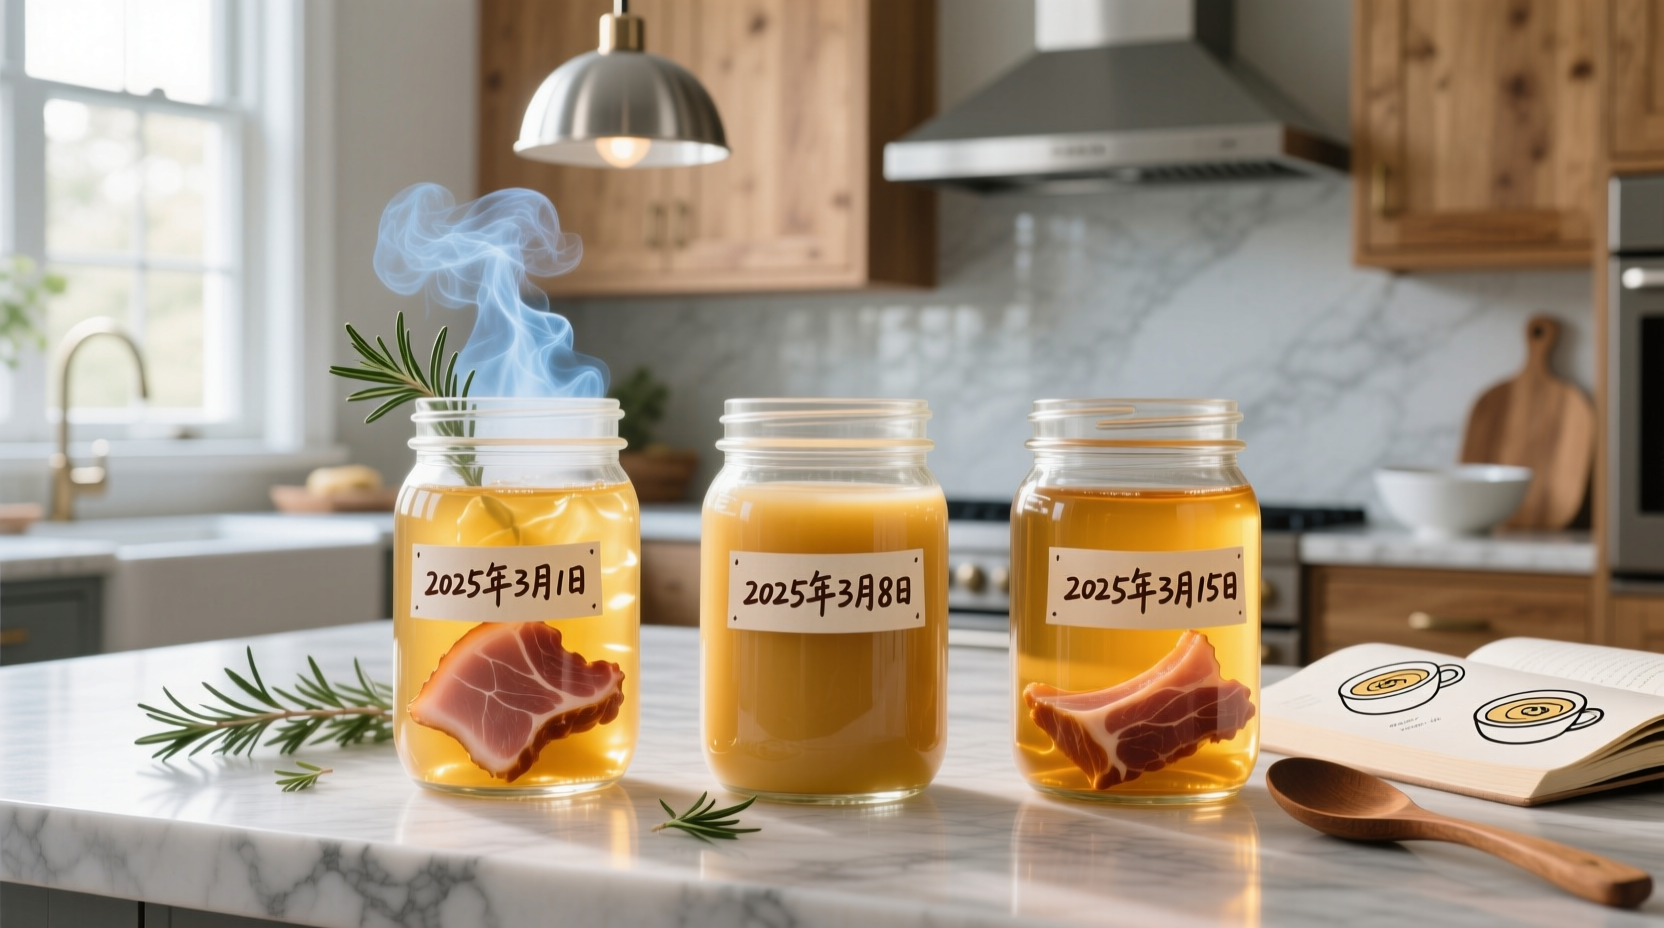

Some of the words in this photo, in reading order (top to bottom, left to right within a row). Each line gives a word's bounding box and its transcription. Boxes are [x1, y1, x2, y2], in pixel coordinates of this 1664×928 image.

[424, 562, 585, 608] 2025年3月1日
[743, 570, 911, 617] 2025年3月8日
[1063, 567, 1237, 615] 2025年3月15日
